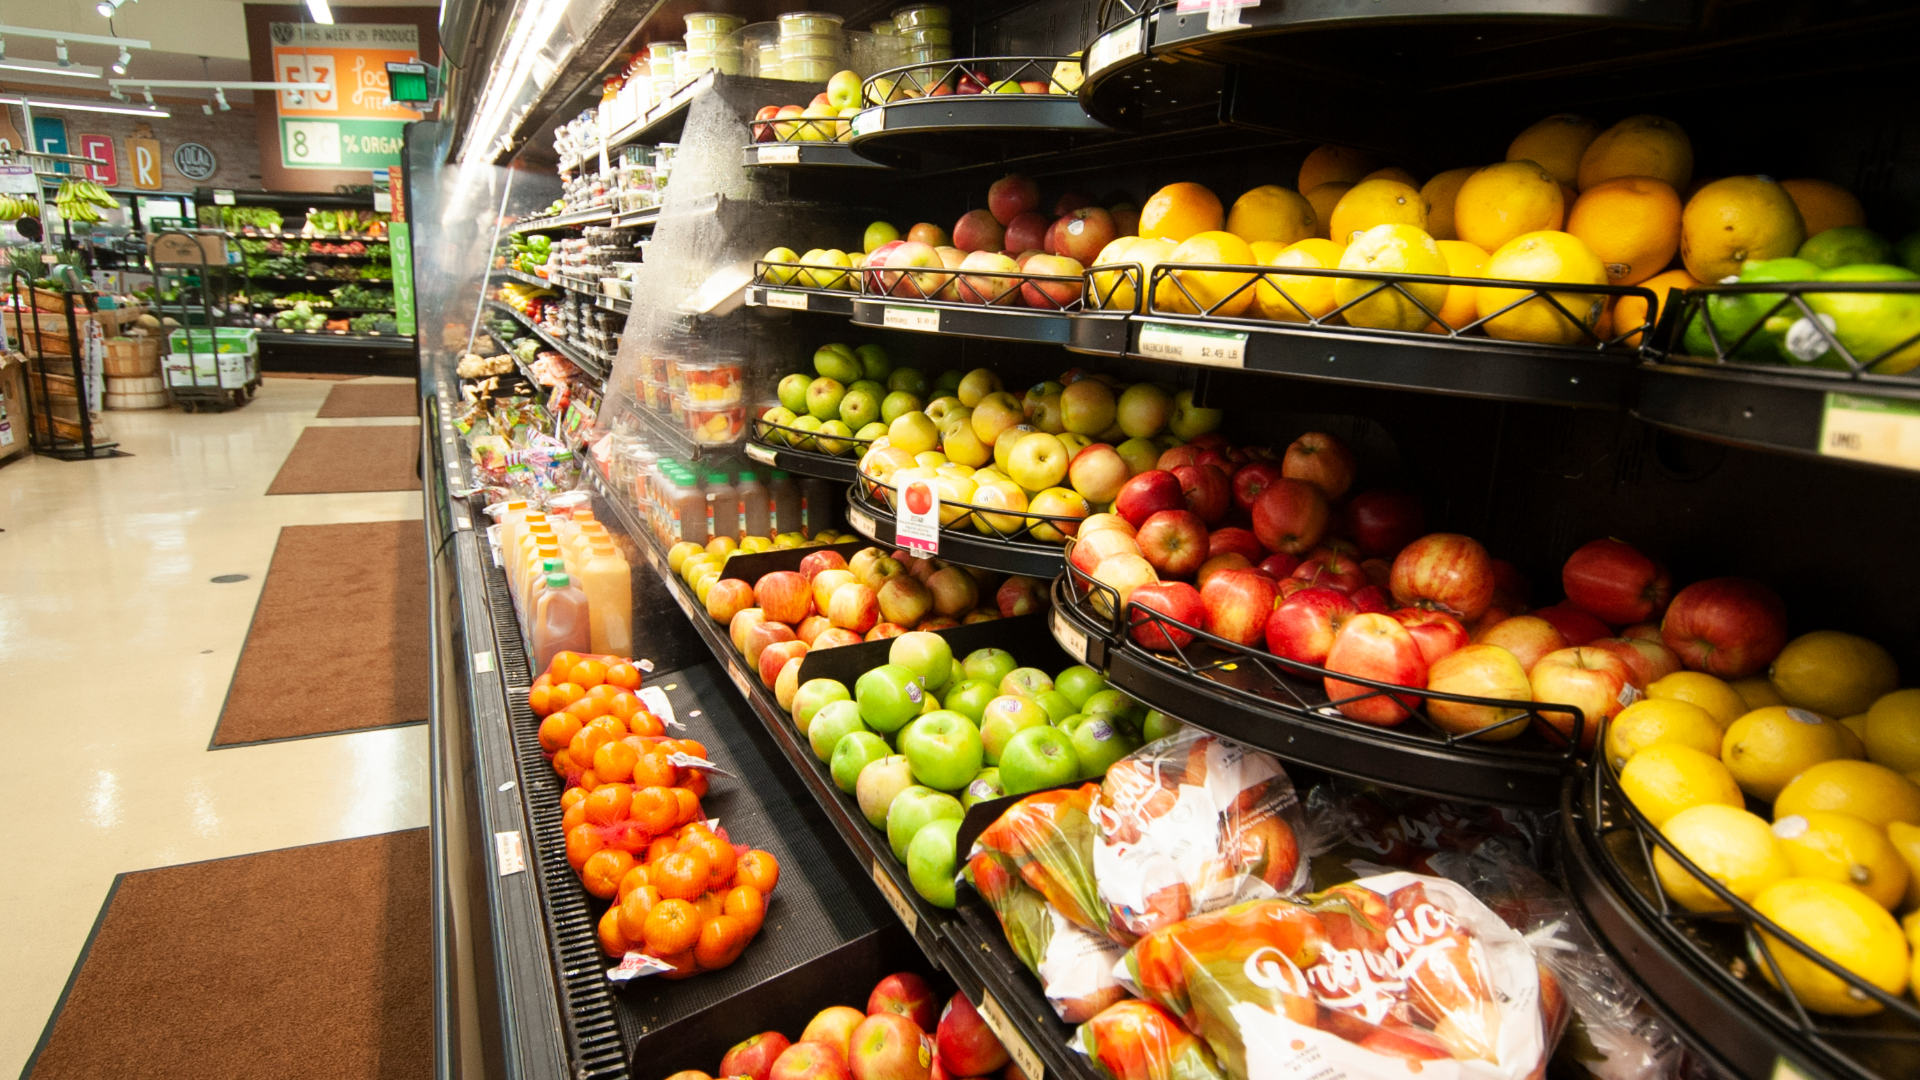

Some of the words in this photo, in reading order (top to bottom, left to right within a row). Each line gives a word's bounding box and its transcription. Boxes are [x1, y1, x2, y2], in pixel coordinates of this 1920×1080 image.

[297, 27, 320, 41] THIS
[324, 28, 352, 42] WEEK
[371, 28, 417, 43] PRODUCE
[342, 134, 360, 154] %
[394, 235, 411, 318] SALAD
[1201, 346, 1224, 358] $2.49
[1227, 349, 1238, 359] LB
[1243, 903, 1460, 1026] Organic
